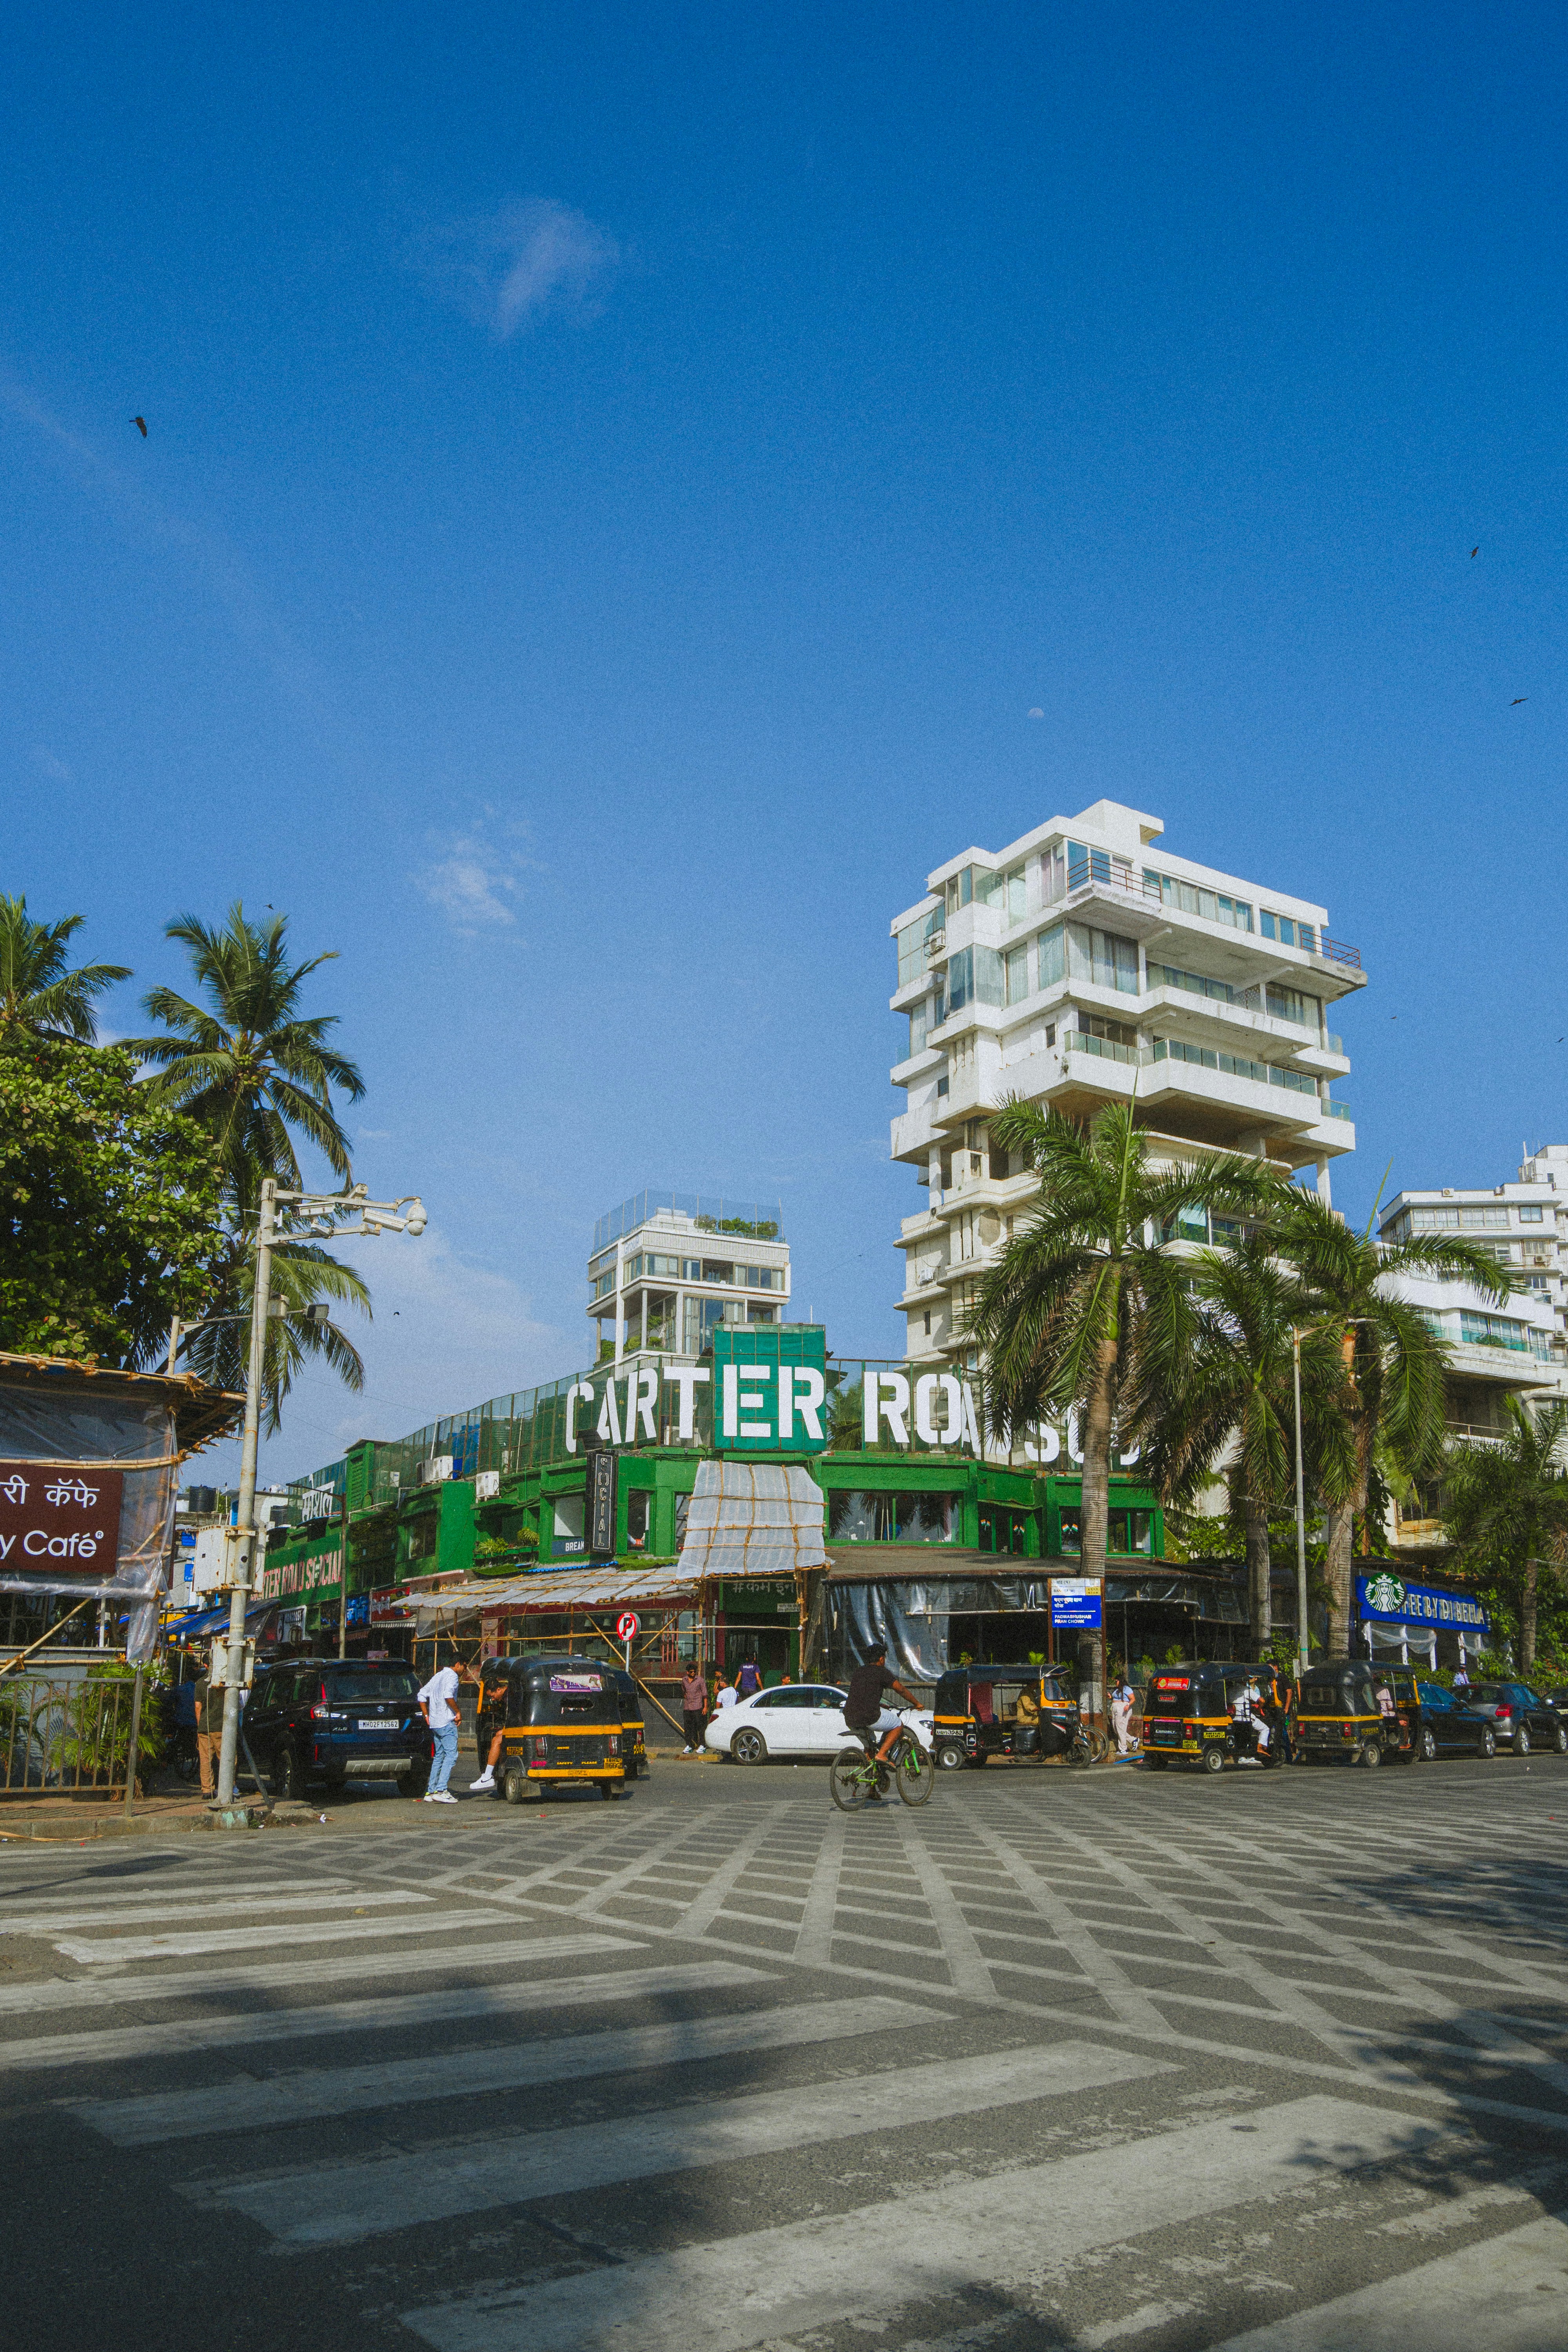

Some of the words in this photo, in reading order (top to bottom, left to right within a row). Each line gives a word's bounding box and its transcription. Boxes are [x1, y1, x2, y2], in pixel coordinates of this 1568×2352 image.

[566, 1365, 824, 1453] CARTER
[598, 1457, 610, 1546] SOCIAL
[281, 1561, 305, 1596] ROAD
[1423, 1596, 1438, 1619] BY
[1439, 1599, 1453, 1621] DI
[1454, 1601, 1485, 1624] BELLA
